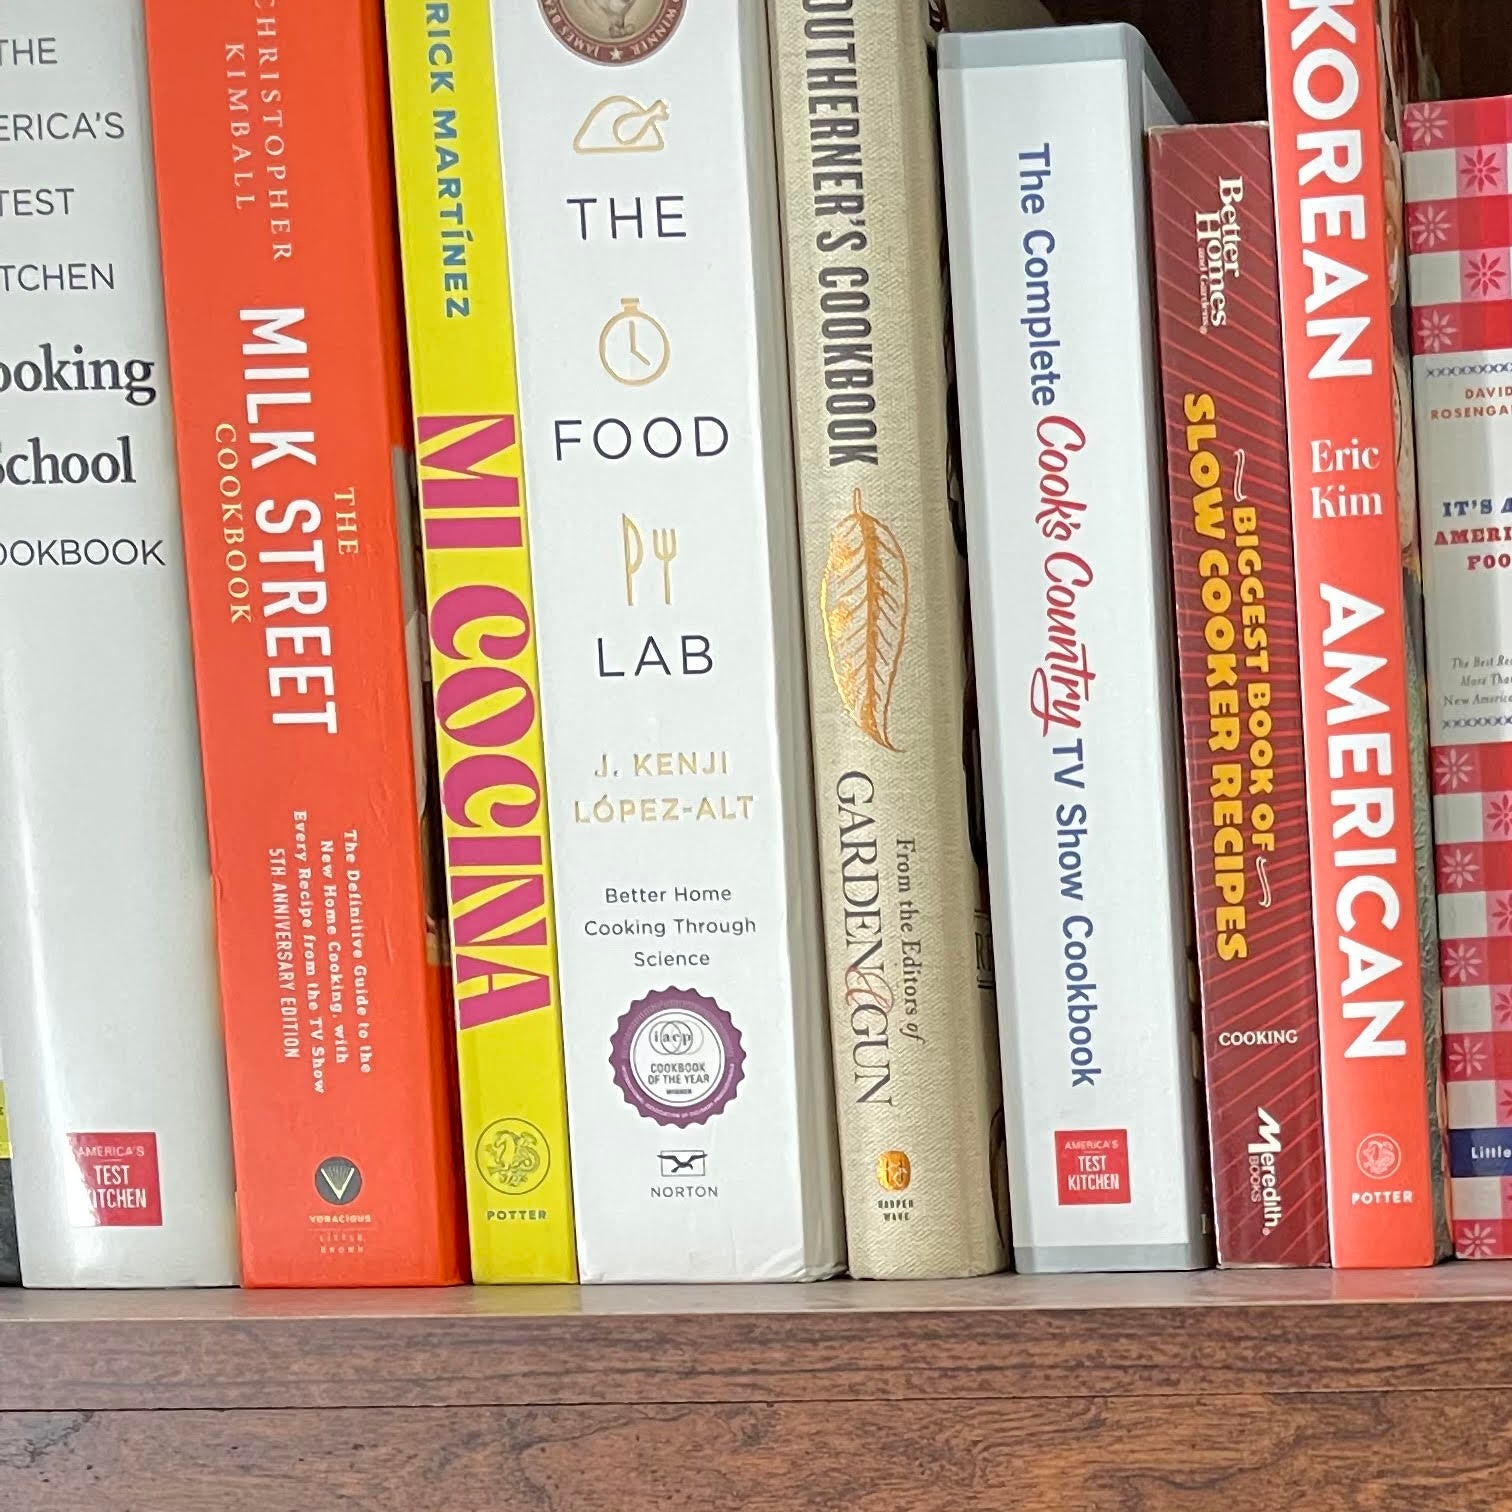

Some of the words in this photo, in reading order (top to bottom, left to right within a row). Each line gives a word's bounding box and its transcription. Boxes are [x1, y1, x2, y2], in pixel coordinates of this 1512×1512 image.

[1018, 143, 1051, 215] The
[431, 108, 475, 319] MARTÍNEZ
[567, 196, 686, 241] THE
[1021, 230, 1061, 406] Complete
[239, 307, 317, 470] MILK
[819, 267, 879, 468] COOKBOOK
[554, 417, 729, 460] FOOD
[1182, 392, 1225, 540] SLOW
[1309, 436, 1380, 475] Eric
[417, 414, 523, 549] MI
[1036, 416, 1086, 541] Cook's
[1310, 484, 1383, 520] Kim
[1442, 496, 1492, 518] IT'S
[214, 423, 252, 623] COOKBOOK
[255, 498, 337, 733] STREET
[1232, 507, 1269, 672] BIGGEST
[598, 634, 714, 677] LAB
[1030, 552, 1097, 738] Country
[1199, 550, 1241, 752] COOKER
[1051, 740, 1085, 790] TV
[1247, 682, 1274, 795] BOOK
[430, 583, 551, 1029] COCINA
[1251, 803, 1275, 852] OF
[1319, 583, 1407, 1059] AMERICAN
[269, 848, 286, 880] 5TH
[896, 838, 915, 893] From
[1056, 804, 1089, 900] Show
[1211, 764, 1247, 961] RECIPES
[605, 886, 667, 904] Better
[675, 885, 732, 903] Home
[899, 899, 918, 934] the
[271, 884, 296, 992] ANNIVERSARY
[584, 919, 667, 938] Cooking
[674, 917, 756, 936] Through
[634, 951, 710, 967] Science
[901, 936, 922, 1018] Editors
[280, 997, 300, 1059] EDITION
[1058, 916, 1102, 1086] Cookbook
[903, 1023, 925, 1045] of
[1219, 1031, 1298, 1046] COOKING
[648, 1074, 660, 1084] OF
[663, 1074, 682, 1084] THE
[685, 1073, 710, 1084] YEAR
[650, 1062, 706, 1073] COOKBOOK
[650, 1186, 718, 1198] NORTON
[1068, 1173, 1119, 1191] KITCHEN
[1078, 1154, 1106, 1172] TEST
[487, 1210, 547, 1221] POTTER
